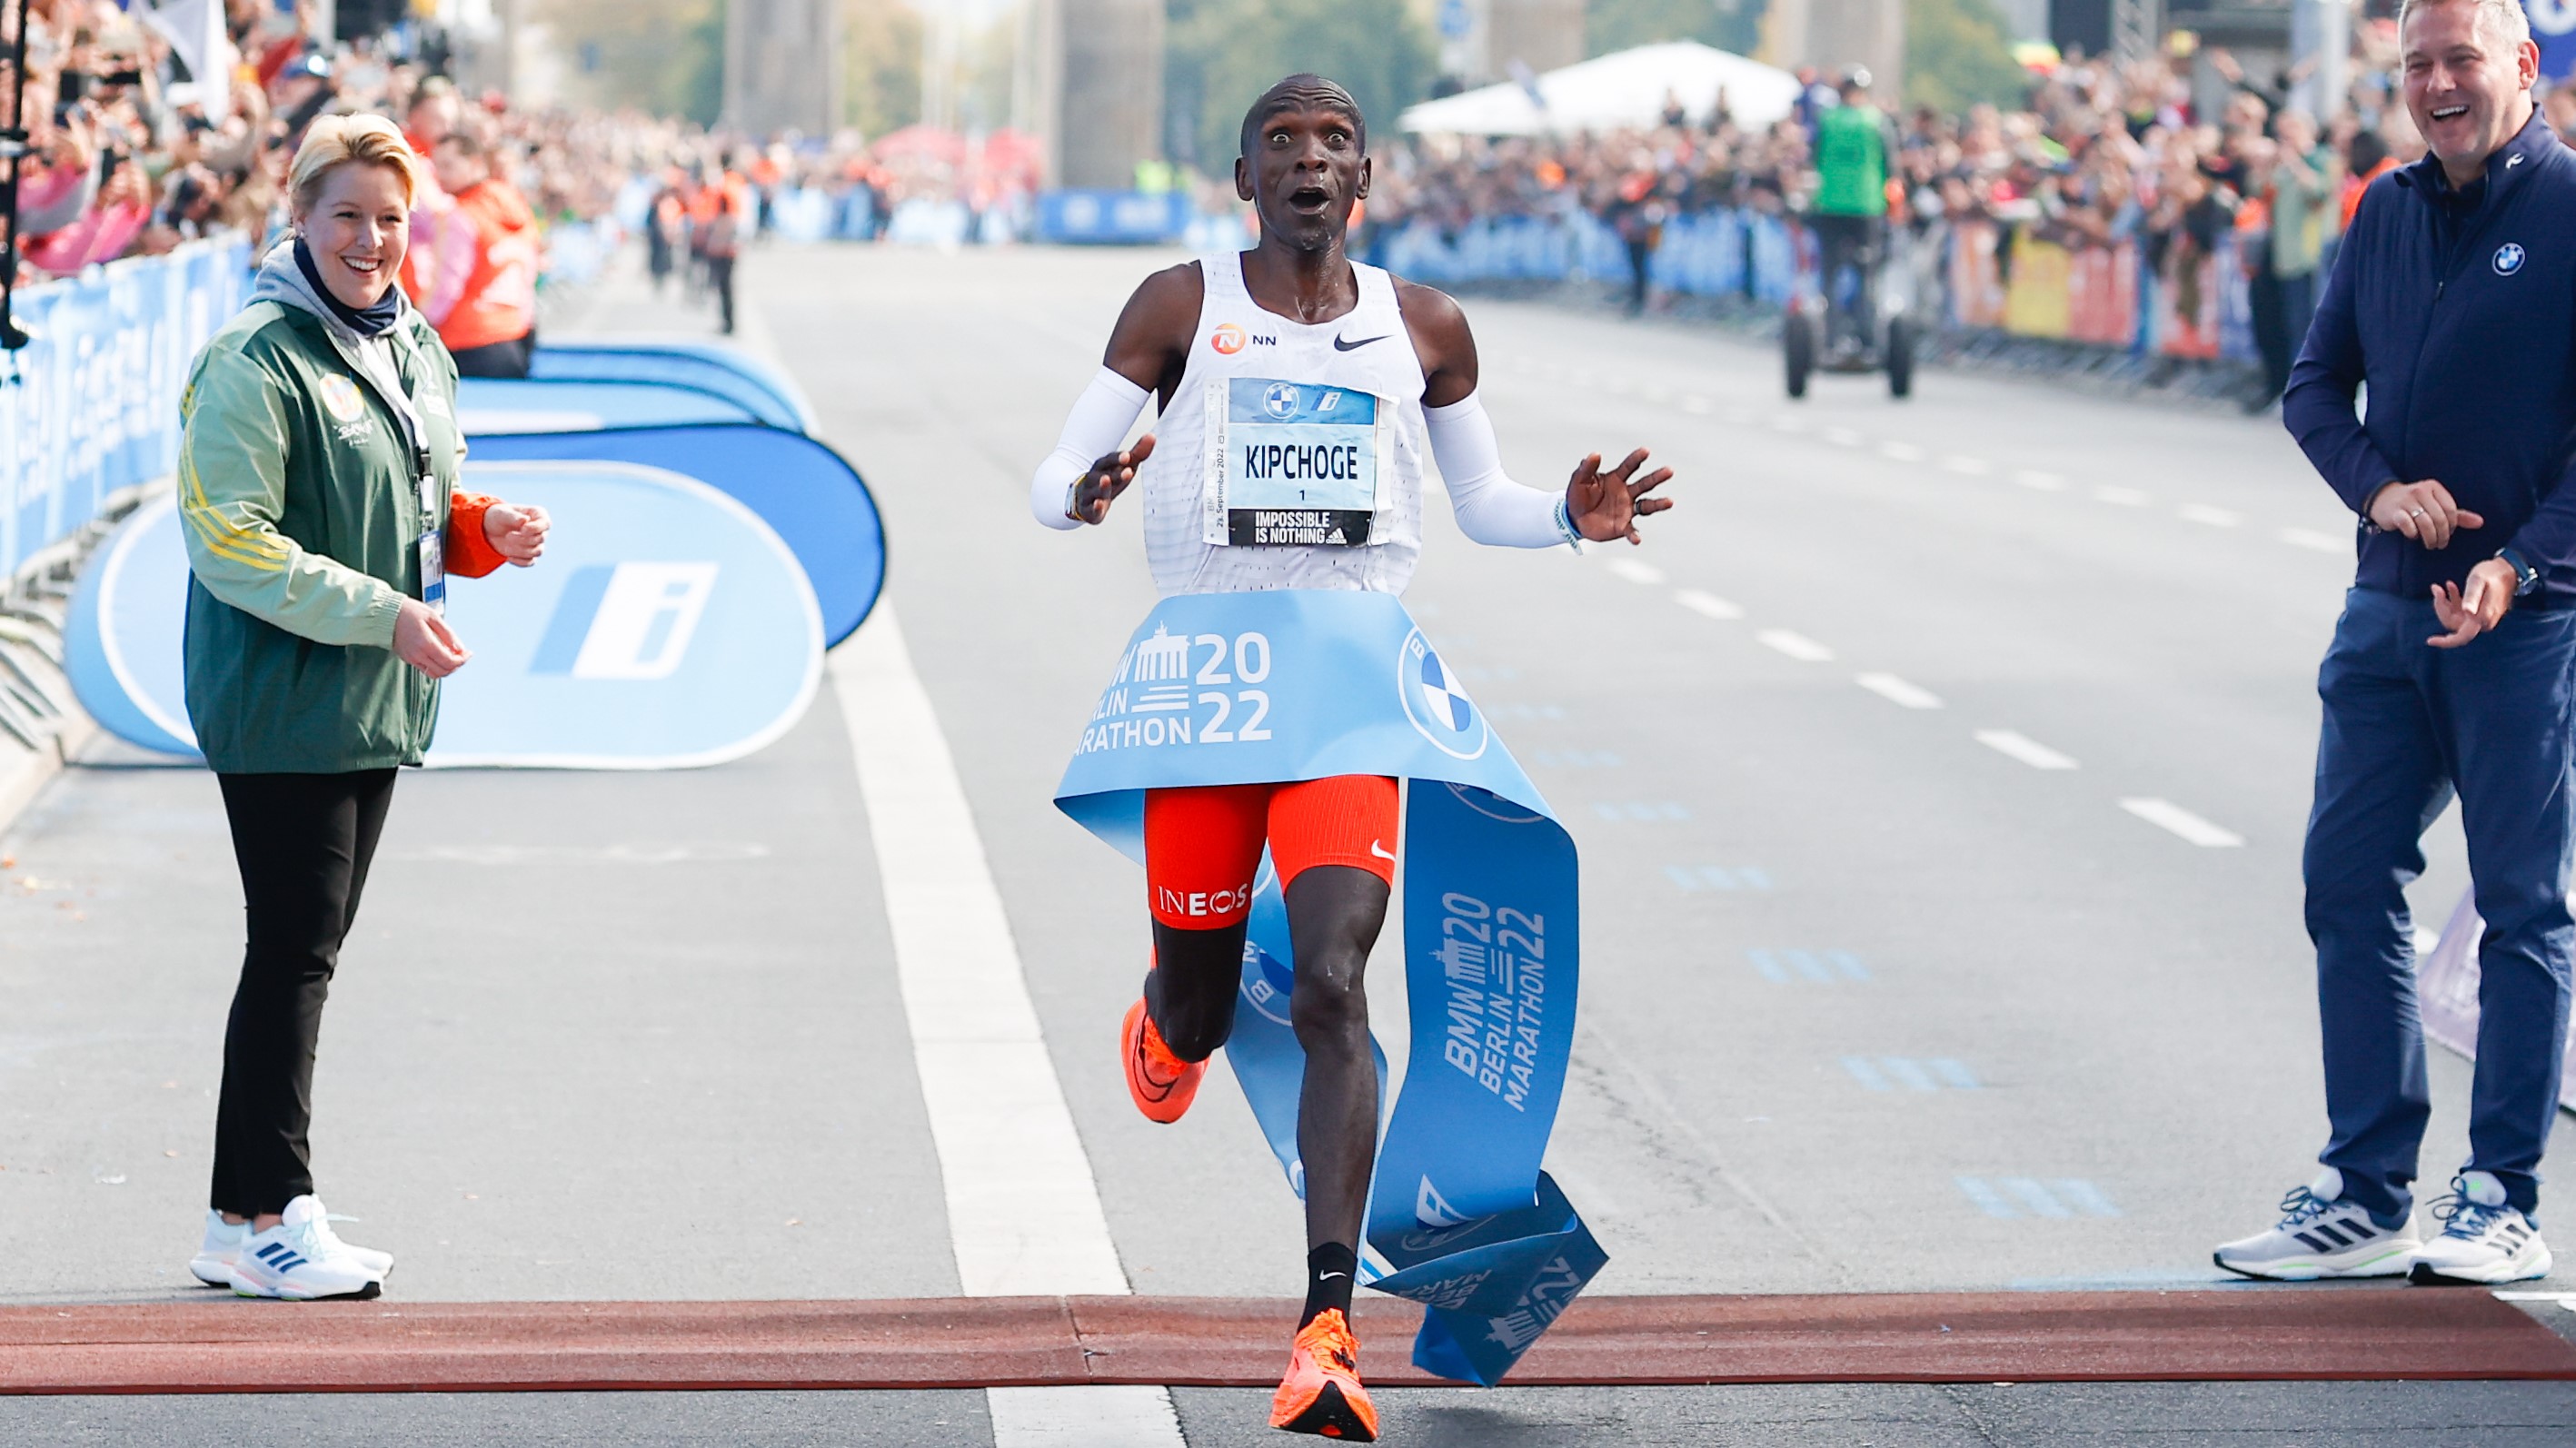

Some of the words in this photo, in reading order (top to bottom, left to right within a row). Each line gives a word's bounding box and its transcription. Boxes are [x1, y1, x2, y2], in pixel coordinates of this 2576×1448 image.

[1252, 334, 1277, 346] NN
[1217, 448, 1225, 467] 2022
[1246, 444, 1358, 481] KIPCHOGE
[1216, 468, 1225, 514] September
[1298, 490, 1306, 501] 1
[1255, 511, 1331, 528] IMPOSSIBLE
[1255, 528, 1268, 544] IS
[1269, 528, 1327, 544] NOTHING
[1195, 631, 1271, 685] 20
[1075, 716, 1191, 756] RATHON
[1198, 689, 1272, 743] 22
[1159, 883, 1248, 916] INEOS
[1442, 891, 1491, 944] 20
[1497, 907, 1545, 960] 22
[1444, 980, 1484, 1079] BMW
[1479, 992, 1513, 1096] BERLIN
[1504, 957, 1545, 1113] MARATHON
